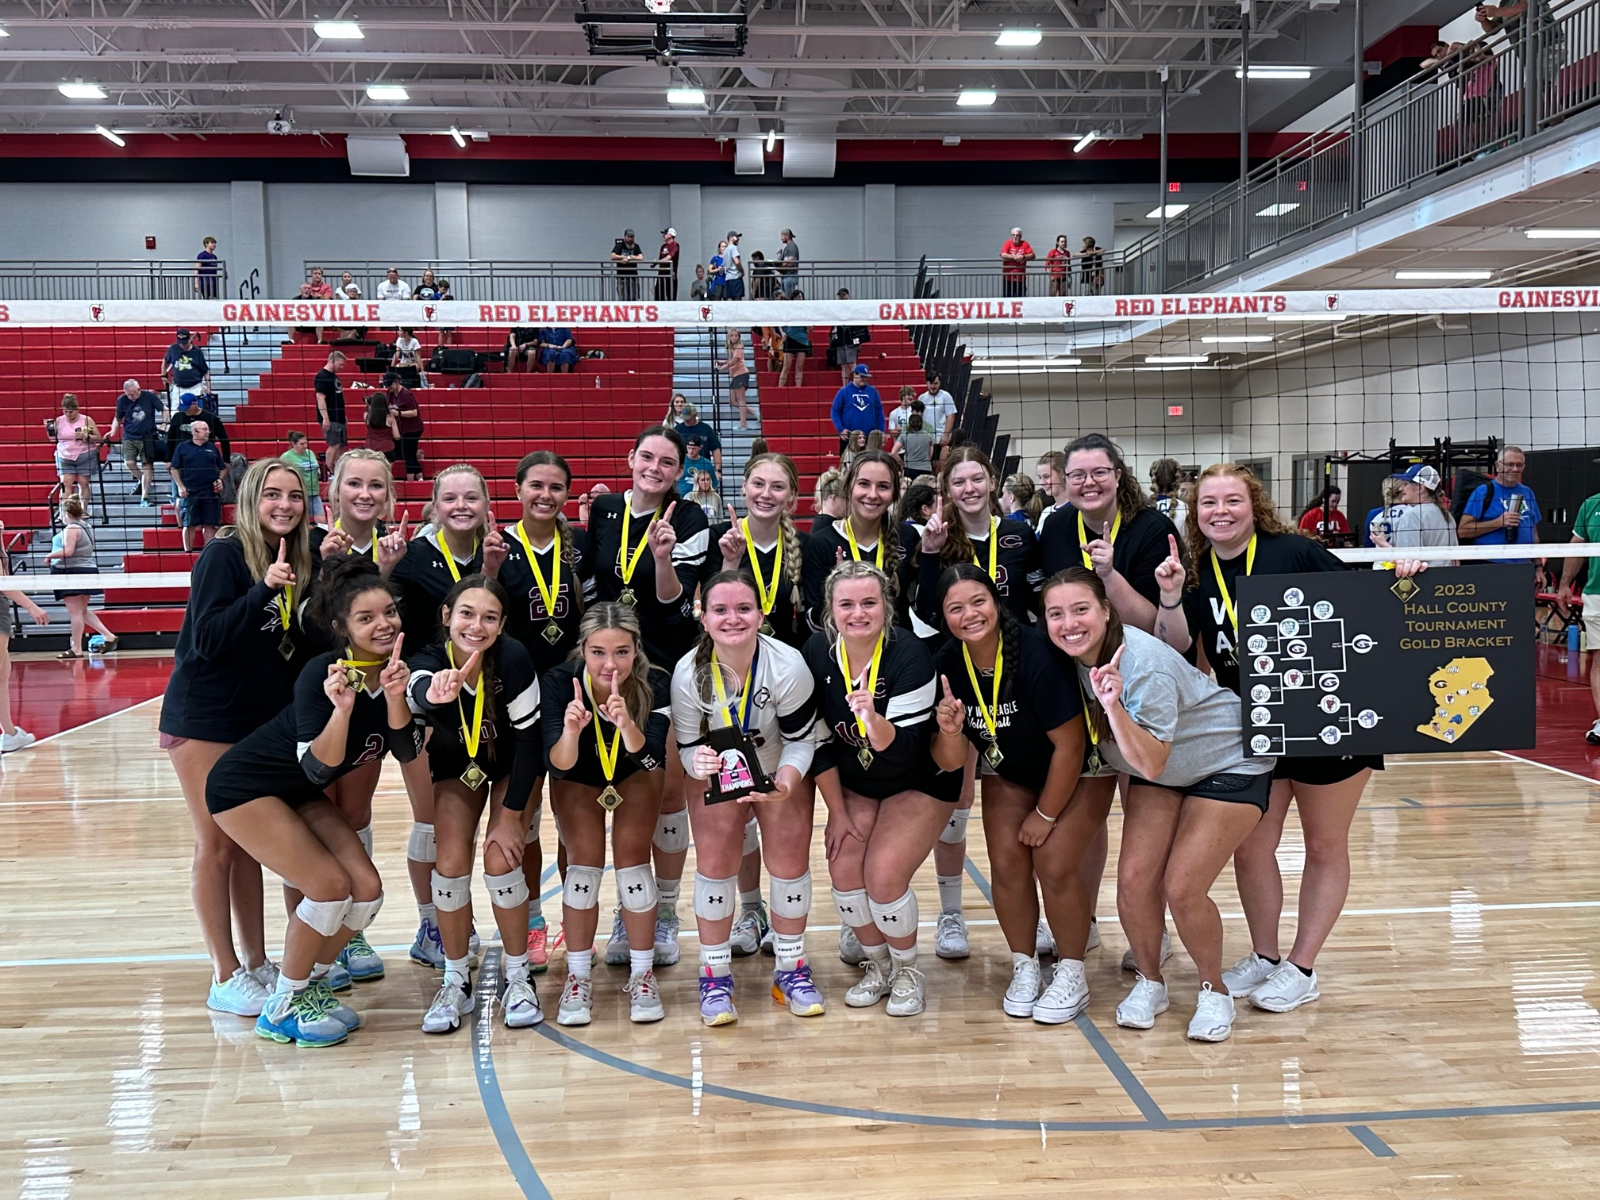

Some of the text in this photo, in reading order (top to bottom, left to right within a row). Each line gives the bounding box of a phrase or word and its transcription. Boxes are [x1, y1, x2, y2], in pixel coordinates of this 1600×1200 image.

[1115, 294, 1287, 317] RED ELEPHANTS
[1498, 289, 1600, 309] GAINESVI
[223, 303, 380, 323] GAINESVILLE
[479, 303, 659, 323] RED ELEPHANTS
[879, 300, 1024, 320] GAINESVILLE
[1434, 583, 1476, 597] 2023
[528, 583, 569, 621] 25
[1404, 601, 1507, 615] HALL COUNTY
[1404, 618, 1507, 633] TOURNAMENT
[1399, 635, 1514, 650] GOLD BRACKET
[352, 733, 384, 766] 2
